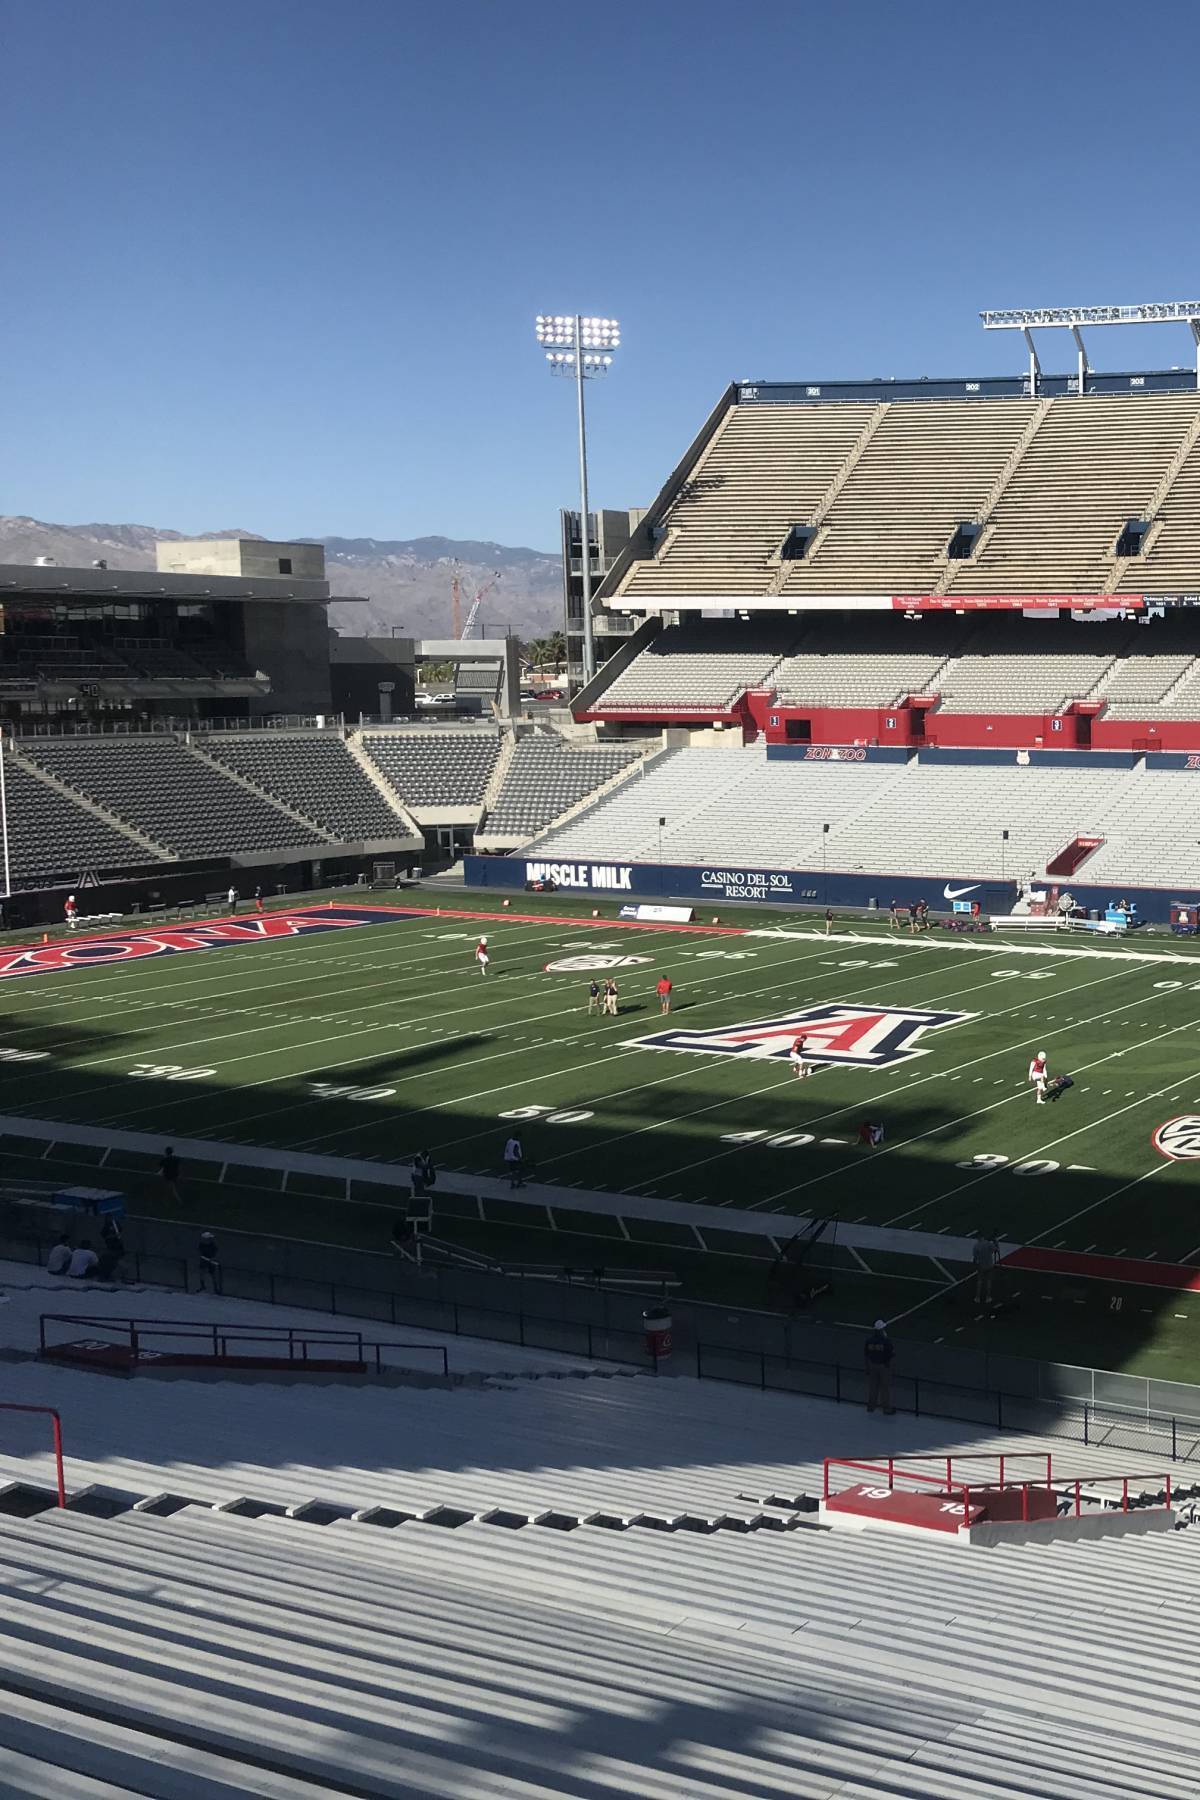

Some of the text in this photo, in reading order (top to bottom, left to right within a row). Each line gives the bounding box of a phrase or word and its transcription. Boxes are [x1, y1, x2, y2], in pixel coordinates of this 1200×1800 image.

[966, 383, 980, 391] 202
[526, 862, 632, 889] MUSCLE MILK
[701, 871, 792, 887] CASINO DEL SOL
[725, 885, 768, 898] RESORT
[990, 969, 1056, 980] 50
[498, 1105, 594, 1124] 50
[719, 1129, 817, 1149] 40
[955, 1153, 1060, 1177] 30
[857, 1486, 892, 1499] 19
[939, 1502, 975, 1515] 18
